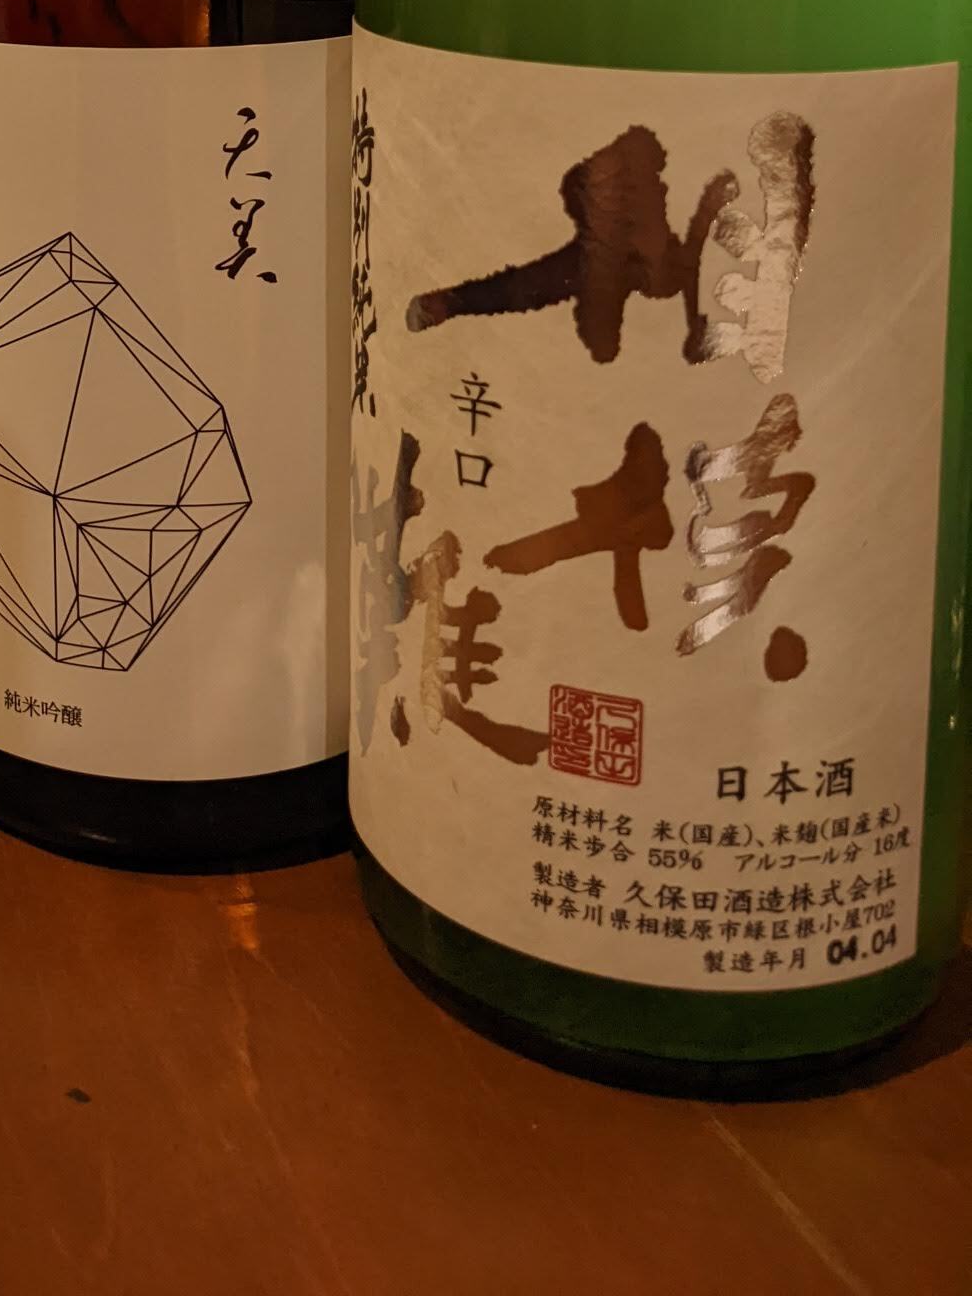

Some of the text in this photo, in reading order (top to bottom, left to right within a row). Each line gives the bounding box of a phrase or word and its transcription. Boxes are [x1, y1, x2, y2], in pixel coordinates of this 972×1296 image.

[450, 371, 502, 490] 辛口
[4, 688, 83, 728] 純米吟醸
[716, 757, 856, 805] 日本酒
[532, 795, 634, 837] 原材料名
[532, 821, 911, 873] 精米歩合 55% アルコール分 16度
[532, 860, 898, 916] 製造者 久保田酒造株式会社
[703, 922, 898, 974] 製造年月 04.04
